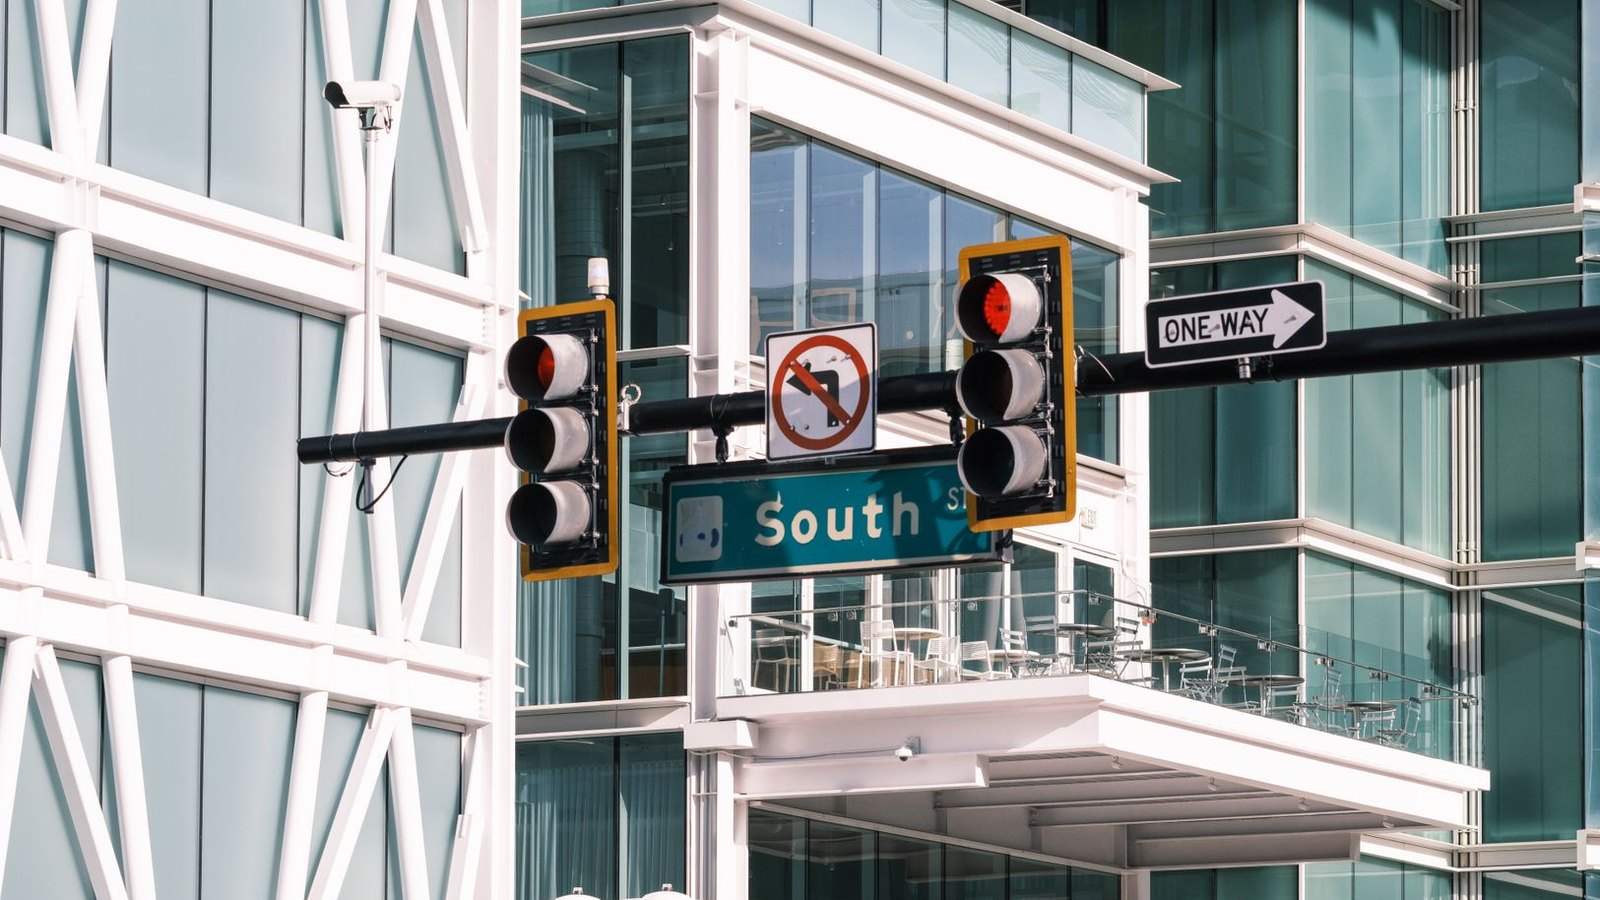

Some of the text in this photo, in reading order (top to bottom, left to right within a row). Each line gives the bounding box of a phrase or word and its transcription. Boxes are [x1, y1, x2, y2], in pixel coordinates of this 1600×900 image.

[1165, 308, 1269, 343] ONE WAY
[755, 491, 919, 546] South
